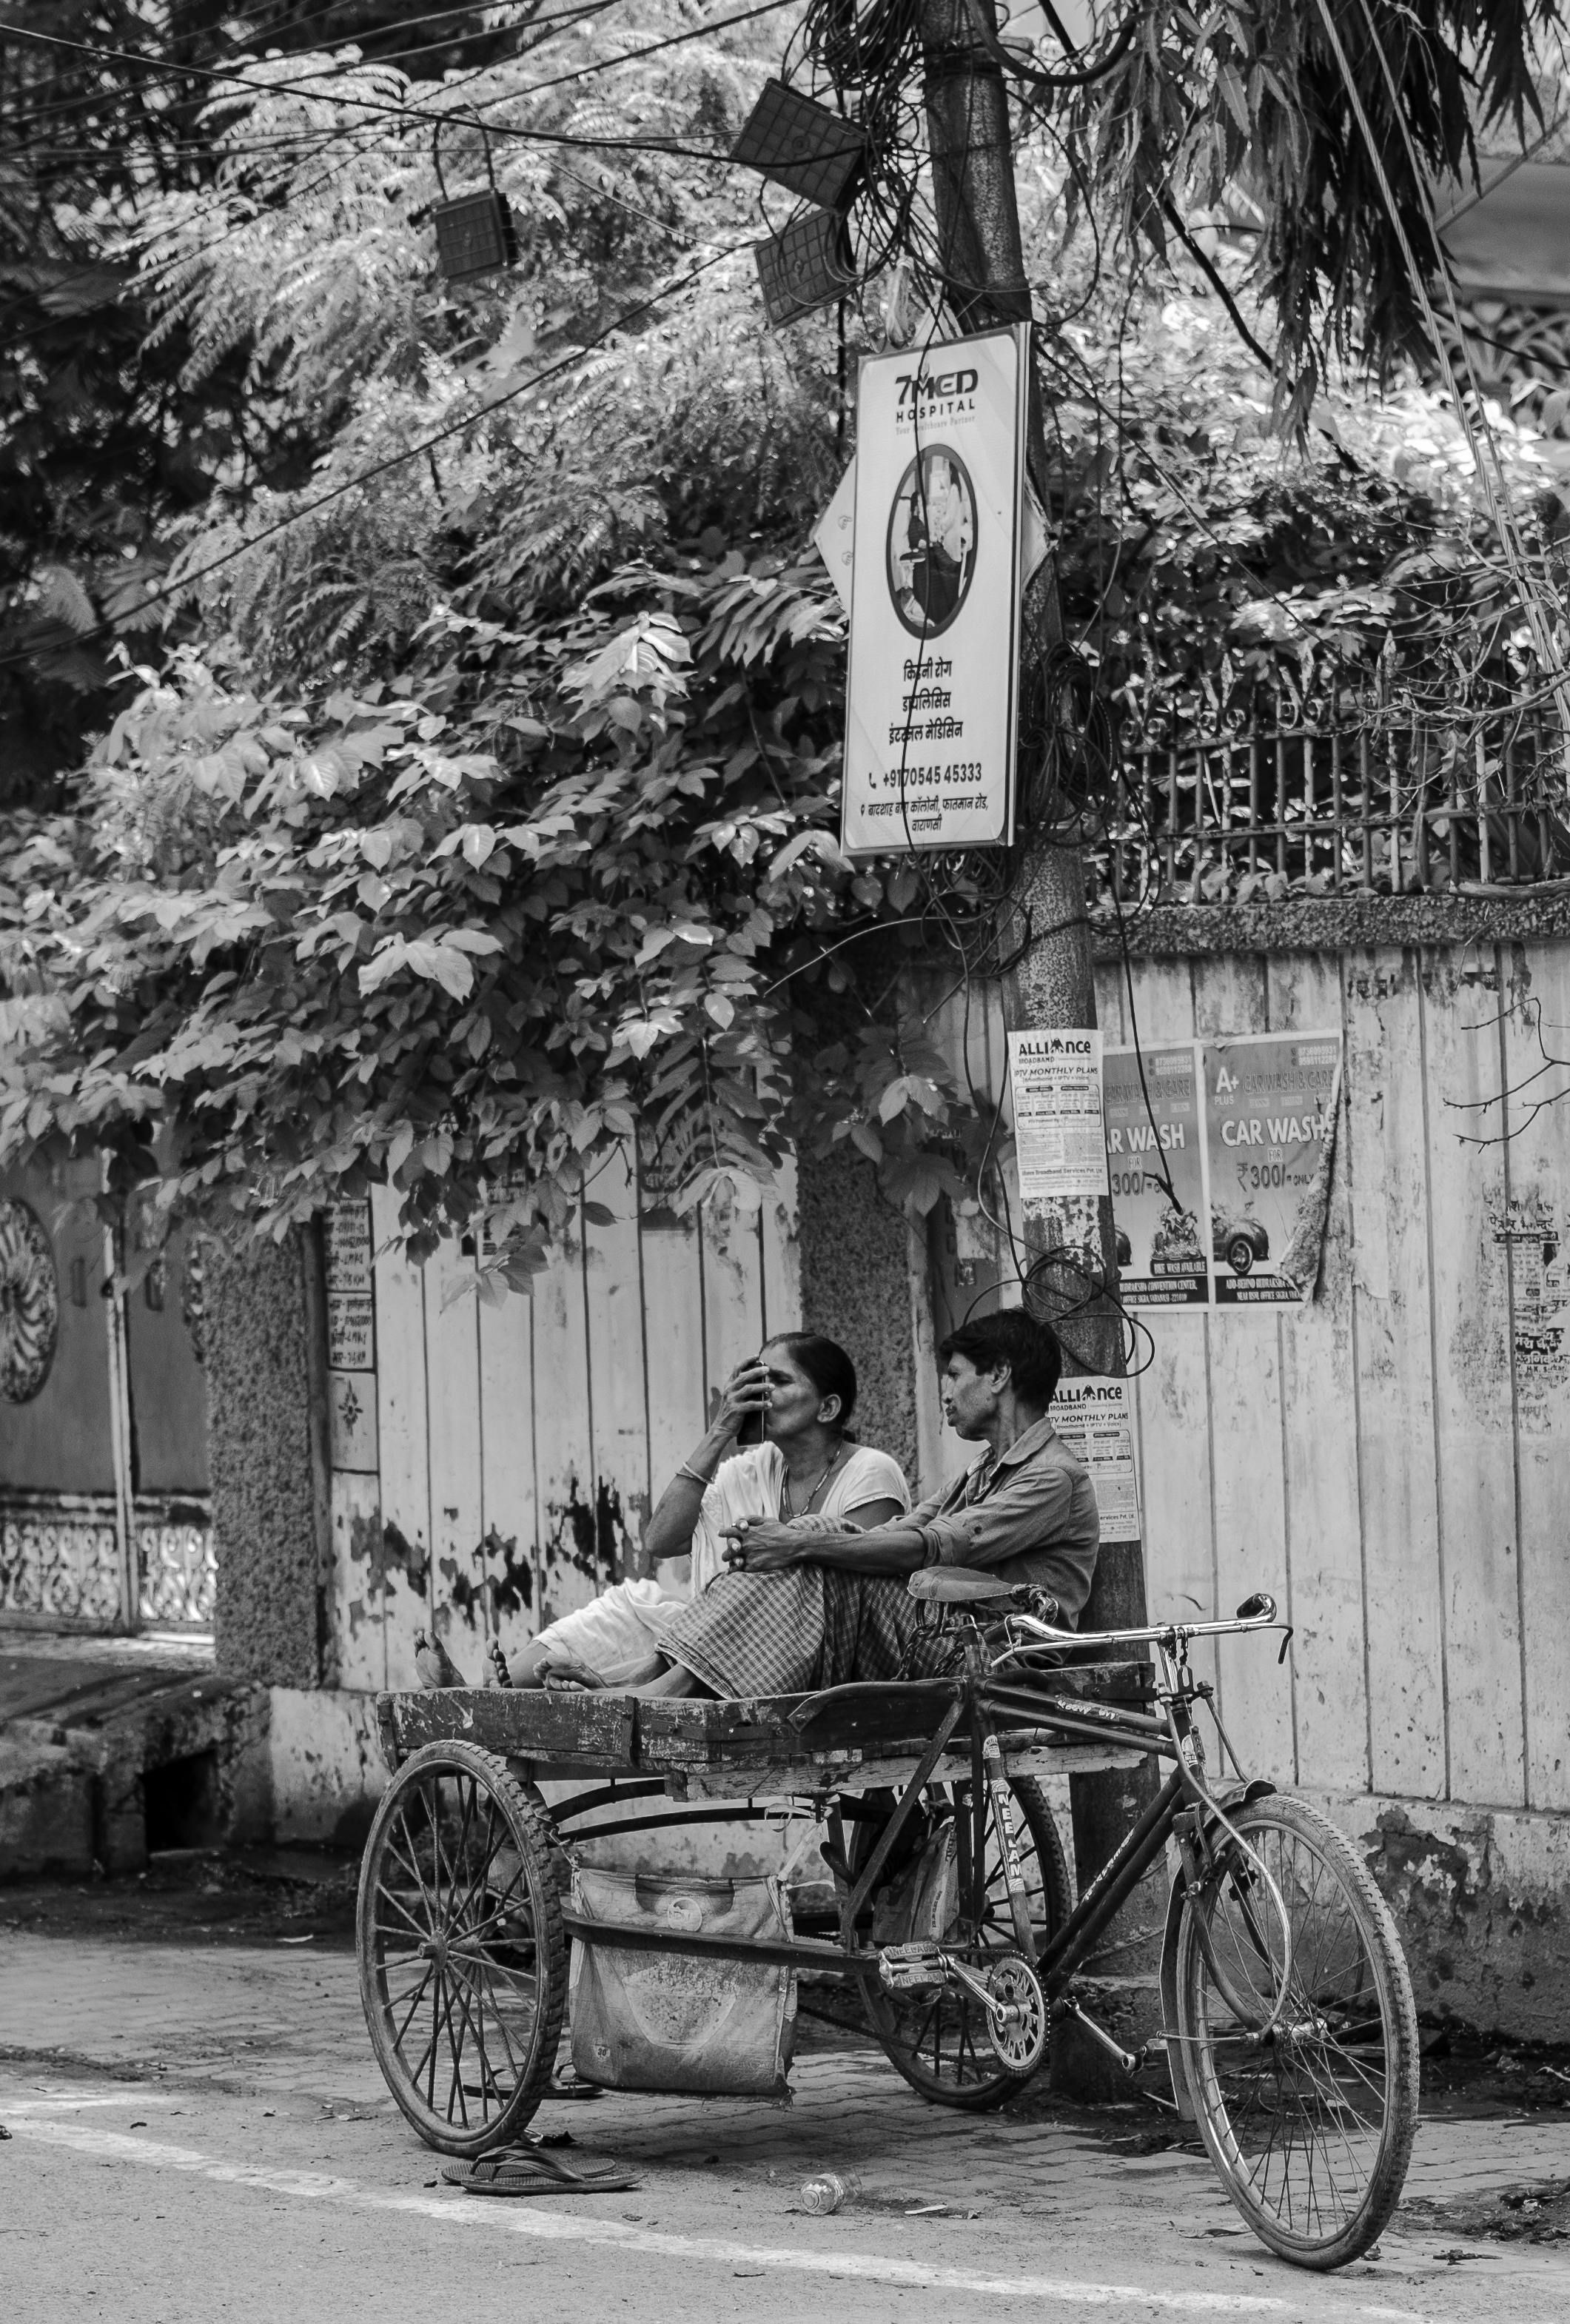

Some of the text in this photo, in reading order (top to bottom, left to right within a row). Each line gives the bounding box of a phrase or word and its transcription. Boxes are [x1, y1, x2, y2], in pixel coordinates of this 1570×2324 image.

[896, 398, 976, 423] HOSPITAL
[935, 656, 953, 679] रोग
[902, 686, 952, 712] डायलिसिस
[925, 716, 964, 740] मेडिसिन
[944, 763, 982, 783] 45333
[868, 803, 893, 816] बादशाह
[942, 797, 974, 811] फातमान
[911, 814, 943, 831] वाराणसी
[1019, 1056, 1055, 1065] BROADBAND
[1030, 1067, 1075, 1076] MONTHLY
[1076, 1066, 1098, 1075] PLANS
[1215, 1066, 1240, 1094] A+
[1214, 1095, 1235, 1106] PLUS
[1127, 1123, 1185, 1153] WASH
[1220, 1113, 1326, 1148] CAR WASH
[1127, 1156, 1142, 1170] FOR
[1267, 1148, 1283, 1162] FOR
[1050, 1403, 1087, 1411] BROADBAND
[1061, 1413, 1107, 1423] MONTHLY
[1108, 1412, 1129, 1420] PLANS
